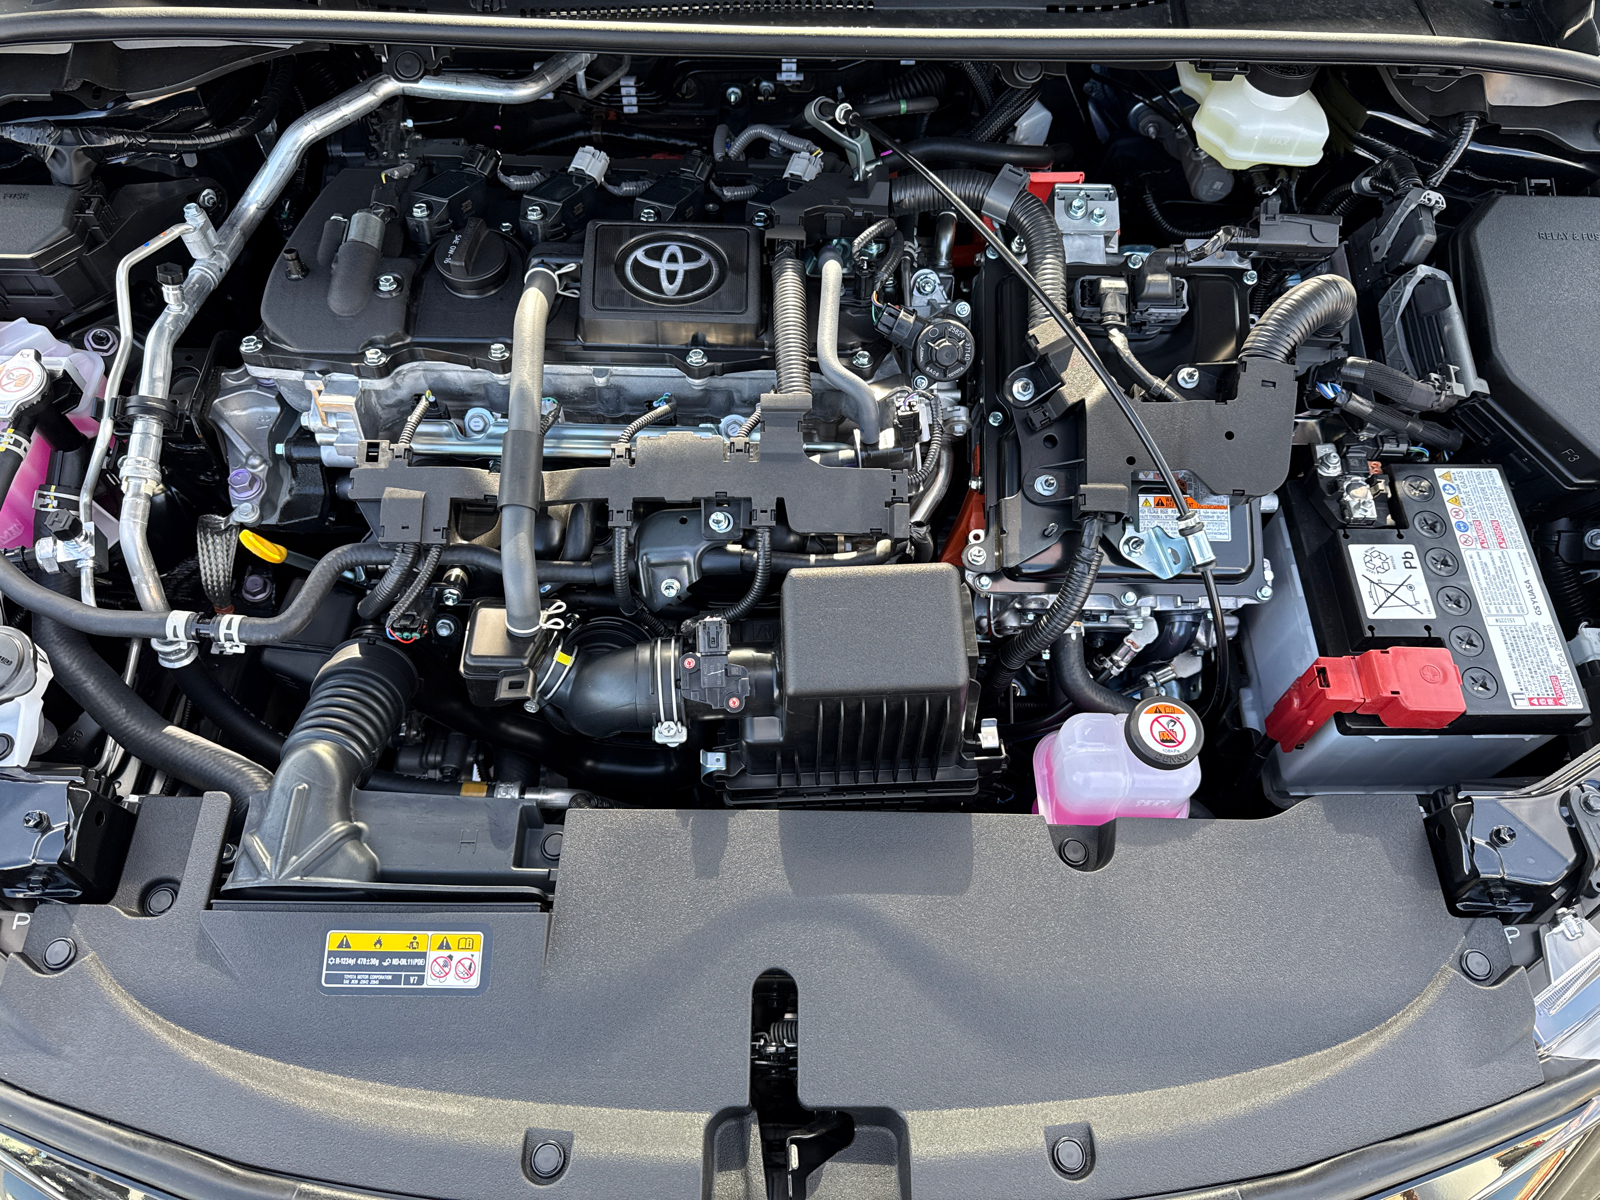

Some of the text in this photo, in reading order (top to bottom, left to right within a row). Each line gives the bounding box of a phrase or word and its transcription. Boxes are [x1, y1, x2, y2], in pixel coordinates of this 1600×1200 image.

[1538, 232, 1568, 240] RELAY
[1573, 232, 1579, 240] &
[443, 234, 462, 264] SAE 0W-16
[1561, 448, 1580, 462] F3
[1455, 470, 1468, 488] GASES
[1473, 471, 1485, 484] BURNS
[1462, 490, 1478, 519] EXPLOSIVE
[1484, 502, 1496, 519] CAUSES
[1472, 520, 1487, 542] DANGER
[1490, 521, 1505, 542] POISON
[1402, 551, 1417, 569] Pb
[1523, 579, 1538, 604] YUASA
[1532, 605, 1542, 615] GS
[1556, 652, 1568, 666] CCA
[1549, 676, 1564, 697] DANGER
[1154, 753, 1189, 763] DENSO
[12, 912, 31, 930] P
[1503, 926, 1520, 945] P
[409, 976, 418, 984] V7
